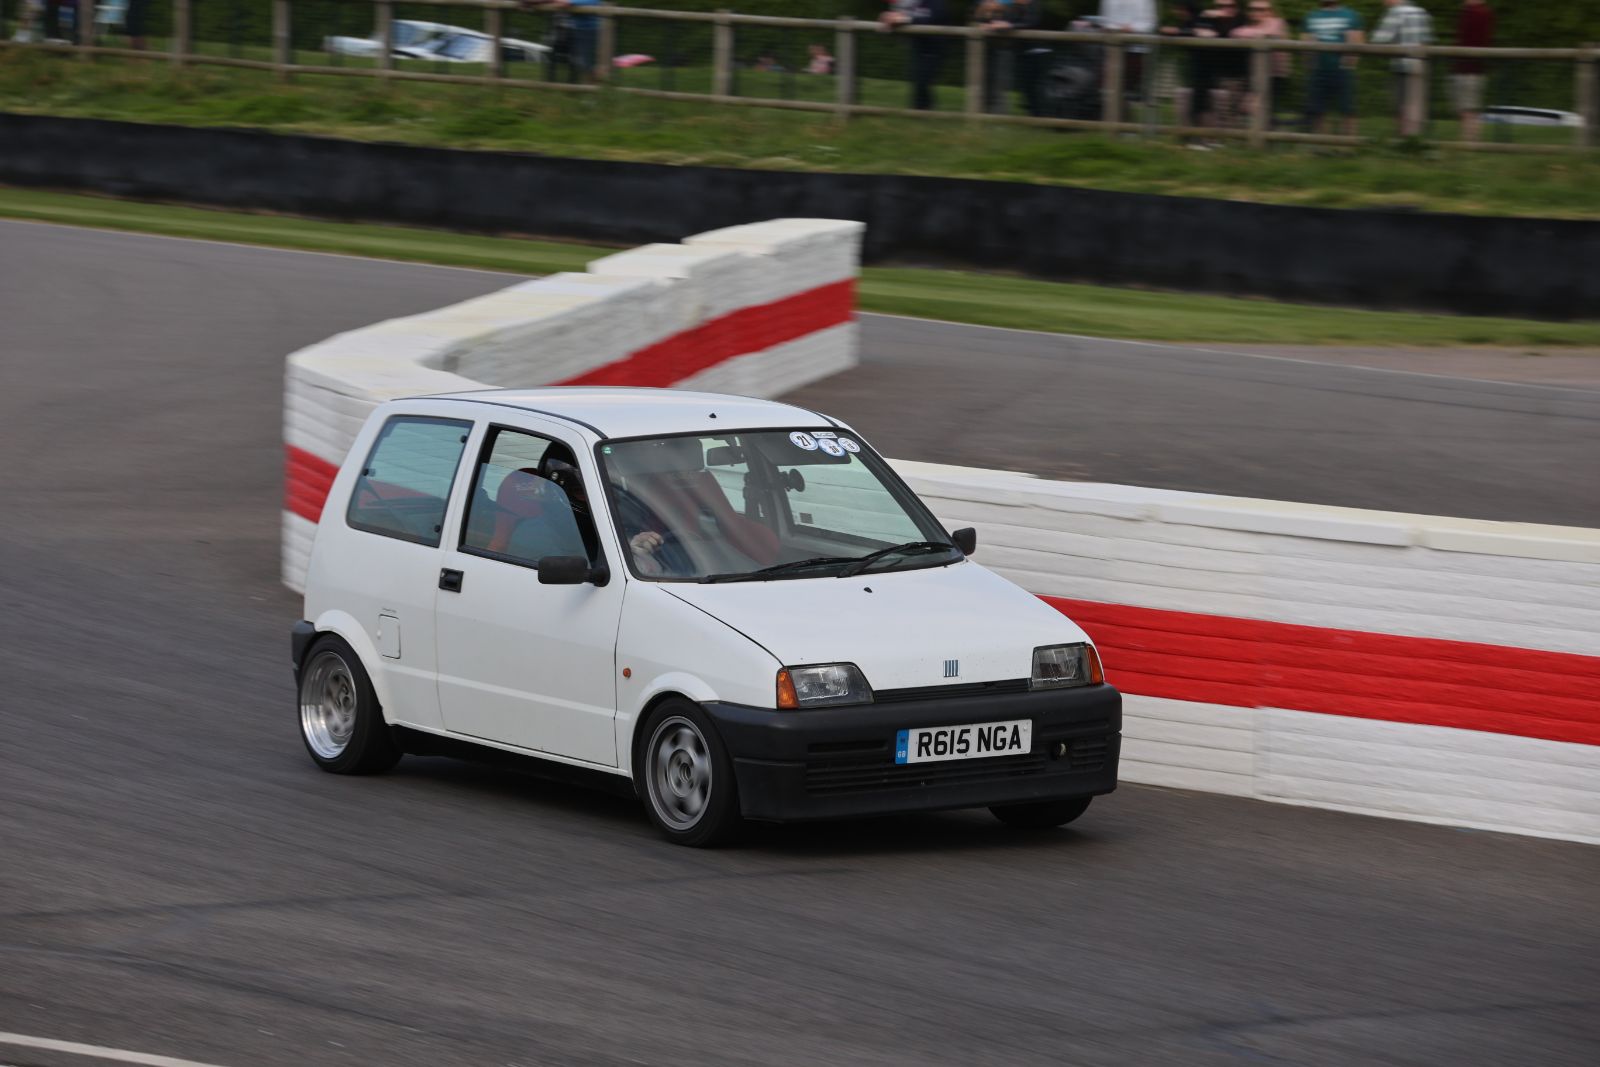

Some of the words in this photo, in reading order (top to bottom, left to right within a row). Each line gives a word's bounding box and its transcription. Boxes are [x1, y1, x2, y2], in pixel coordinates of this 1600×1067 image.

[796, 435, 811, 447] 21
[917, 728, 971, 758] R615
[976, 724, 1022, 753] NGA
